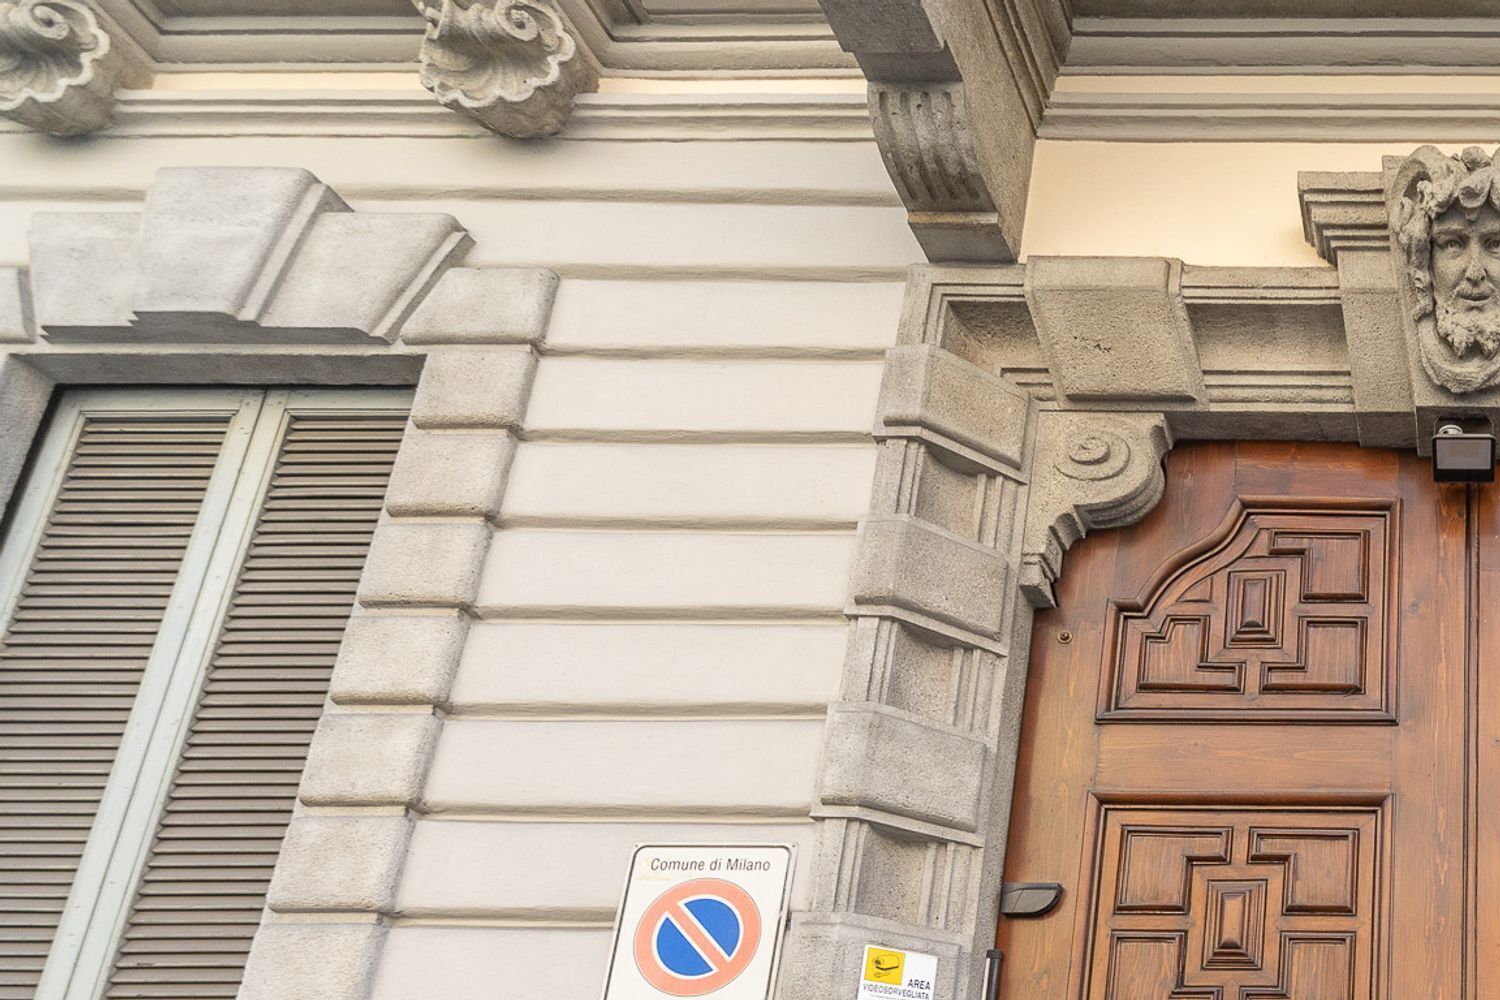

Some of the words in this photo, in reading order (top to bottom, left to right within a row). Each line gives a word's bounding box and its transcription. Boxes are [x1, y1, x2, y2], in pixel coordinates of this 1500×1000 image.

[650, 857, 706, 872] Comune
[709, 858, 723, 871] di
[726, 858, 771, 871] Milano
[863, 983, 930, 1000] VIDEOSORVEGLIATA
[907, 979, 931, 990] AREA
